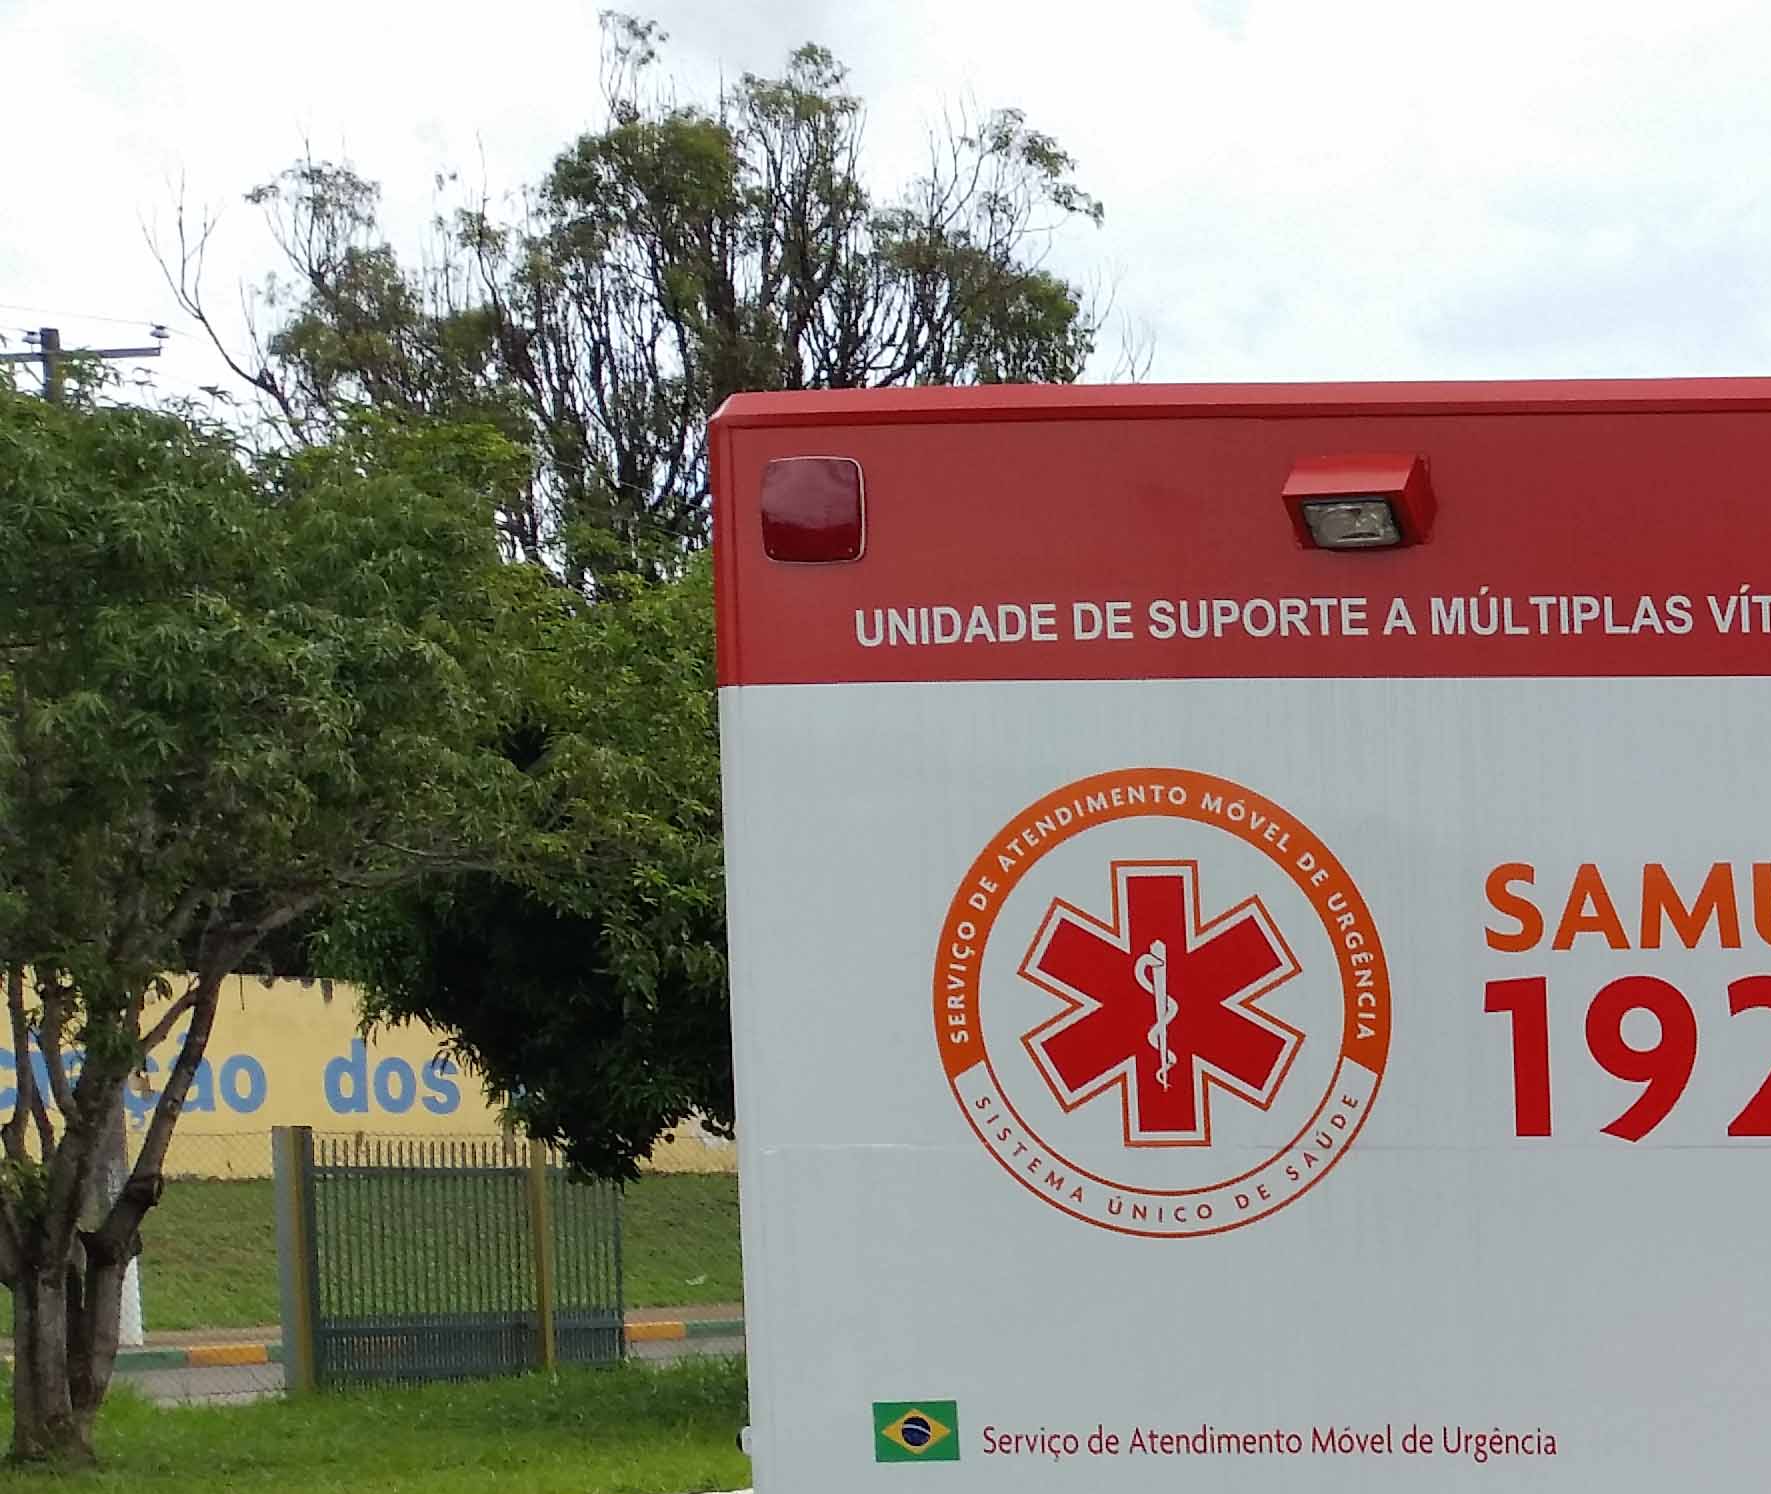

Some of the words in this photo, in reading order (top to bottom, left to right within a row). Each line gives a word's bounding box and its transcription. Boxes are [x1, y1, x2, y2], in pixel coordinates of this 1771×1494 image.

[855, 603, 1059, 647] UNIDADE
[1072, 601, 1136, 641] DE
[1148, 597, 1370, 639] SUPORTE
[1383, 597, 1417, 637] A
[1430, 586, 1694, 636] MÚLTIPLAS
[946, 920, 977, 1044] SERVIÇO
[967, 875, 999, 912] DE
[996, 784, 1188, 874] ATENDIMENTO
[1200, 792, 1292, 853] MÓVEL
[1295, 851, 1330, 887] DE
[1326, 891, 1377, 1041] URGÊNCIA
[323, 1037, 461, 1114] dos
[975, 1095, 1084, 1204] SISTEMA
[1106, 1194, 1213, 1223] ÚNICO
[1235, 1183, 1271, 1211] DE
[1285, 1093, 1359, 1182] SAÚDE
[983, 1426, 1079, 1463] Serviço
[1086, 1424, 1119, 1456] de
[1128, 1423, 1303, 1456] Atendimento
[1310, 1424, 1393, 1456] Móvel
[1401, 1423, 1433, 1456] de
[1442, 1425, 1558, 1463] Urgência
